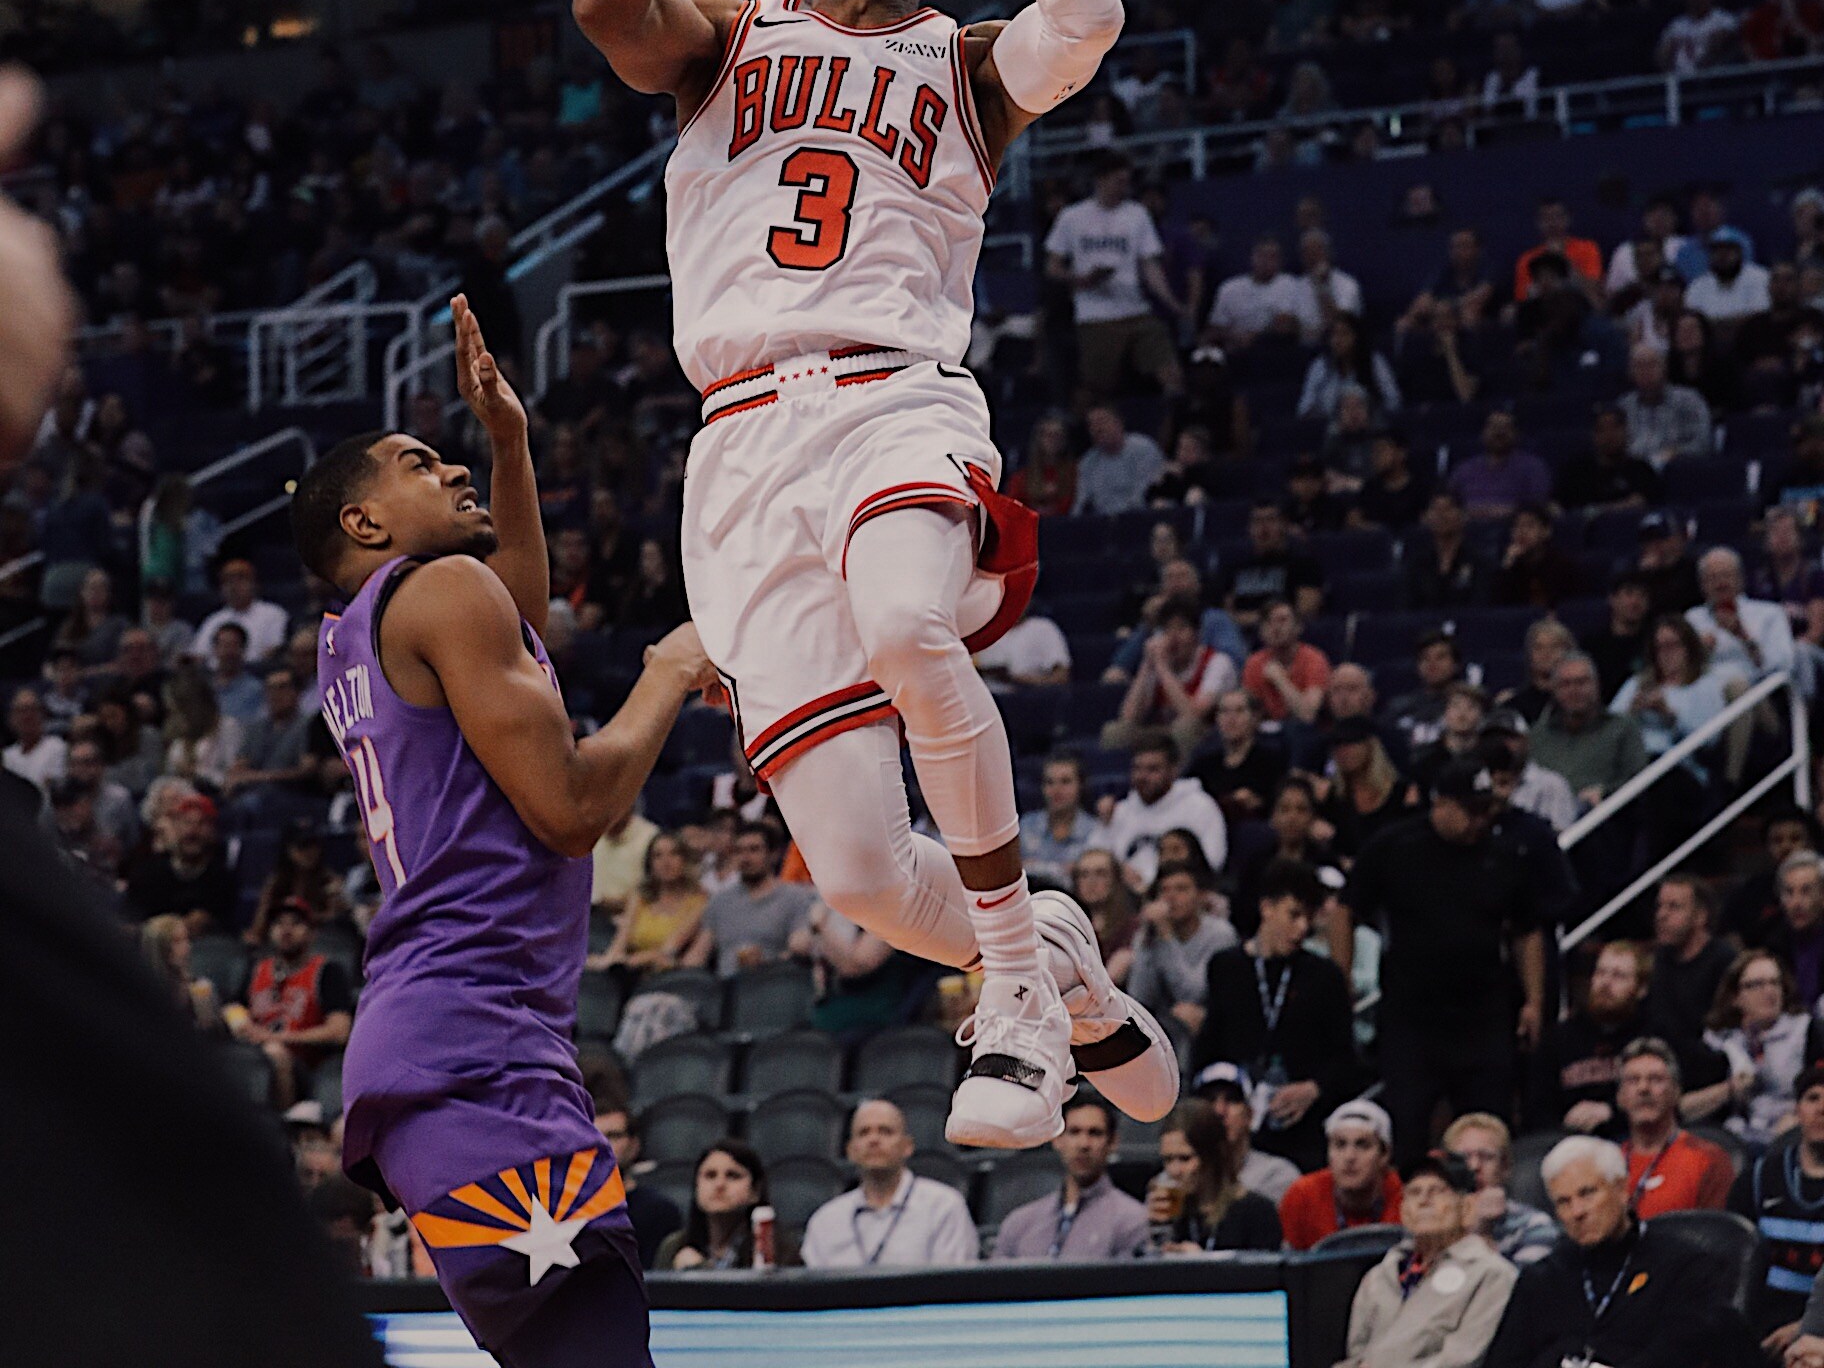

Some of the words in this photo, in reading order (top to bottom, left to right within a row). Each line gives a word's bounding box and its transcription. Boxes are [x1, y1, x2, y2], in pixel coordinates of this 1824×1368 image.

[885, 39, 947, 59] ZENNI
[728, 55, 948, 189] BULLS
[766, 146, 860, 271] 3
[347, 735, 407, 890] 4
